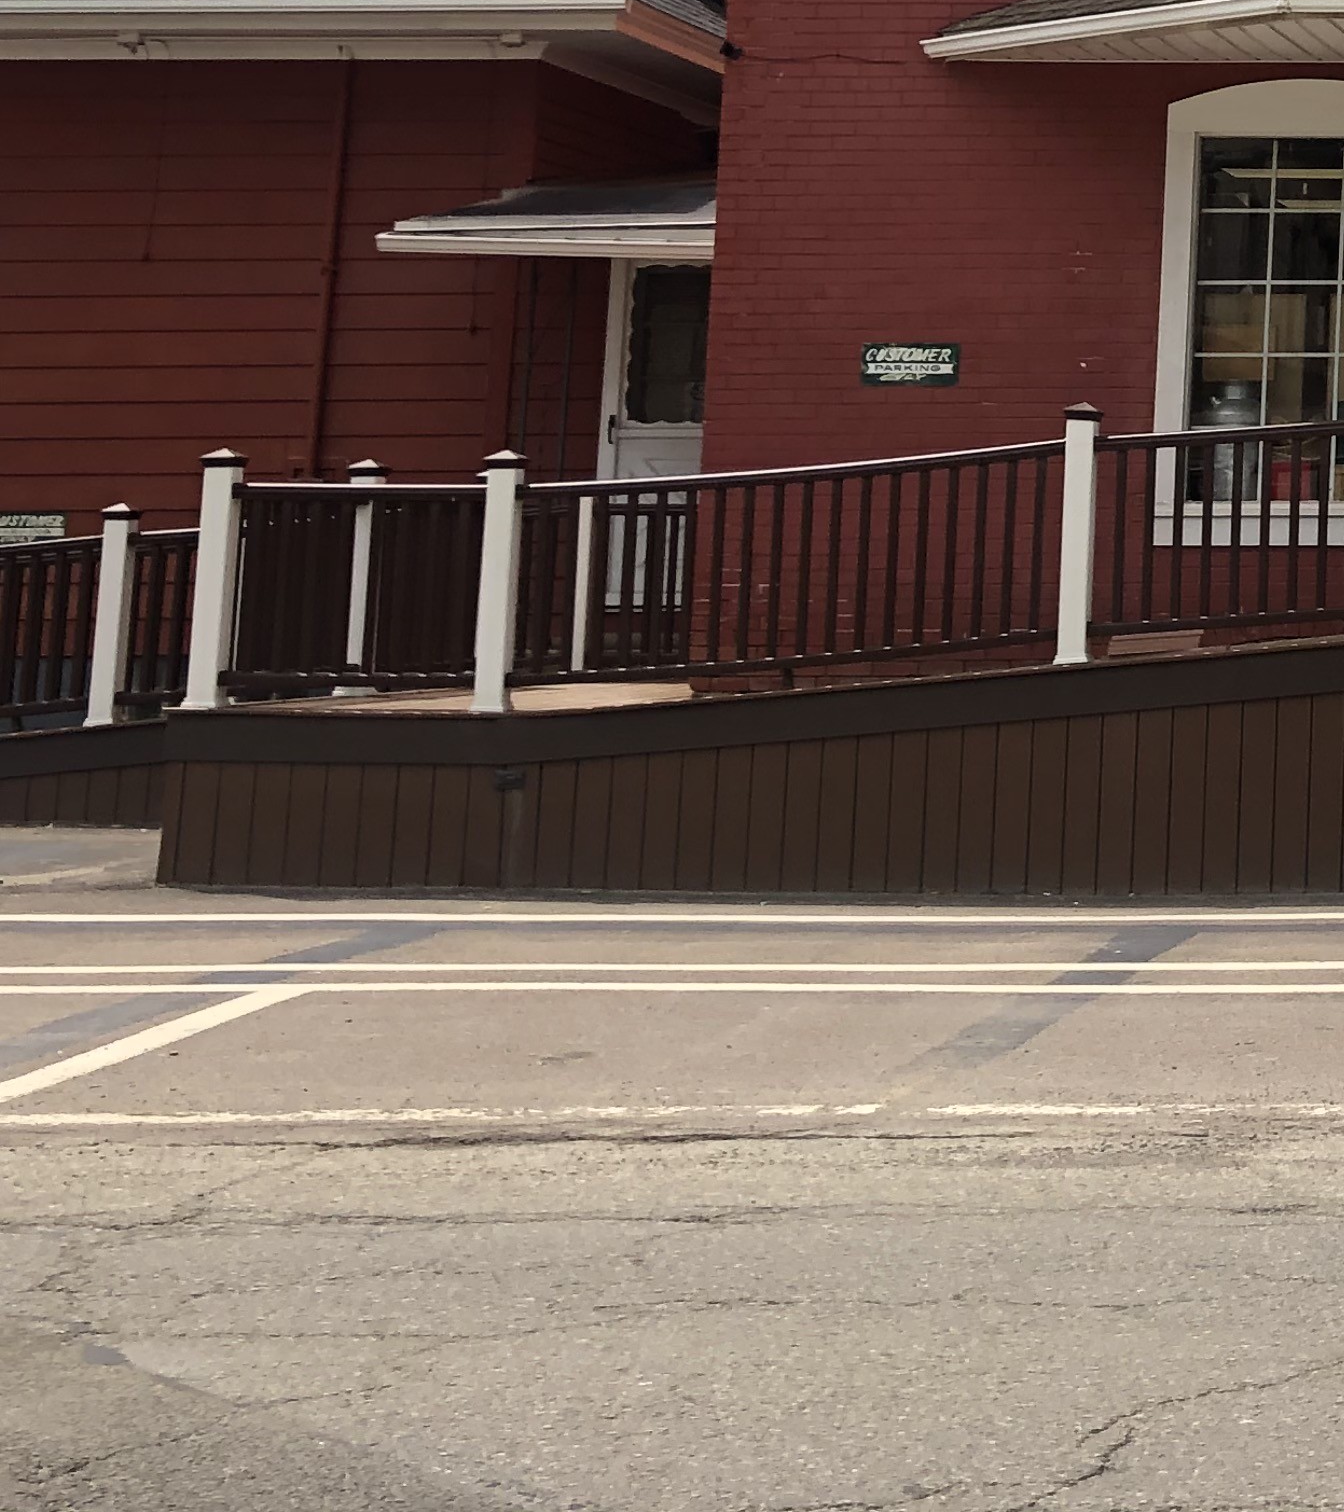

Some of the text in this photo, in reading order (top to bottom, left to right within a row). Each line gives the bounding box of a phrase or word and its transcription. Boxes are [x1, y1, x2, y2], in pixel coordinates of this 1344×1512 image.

[865, 347, 952, 362] CUSTOMER
[874, 364, 941, 372] PARKING
[0, 515, 65, 527] USTOMER
